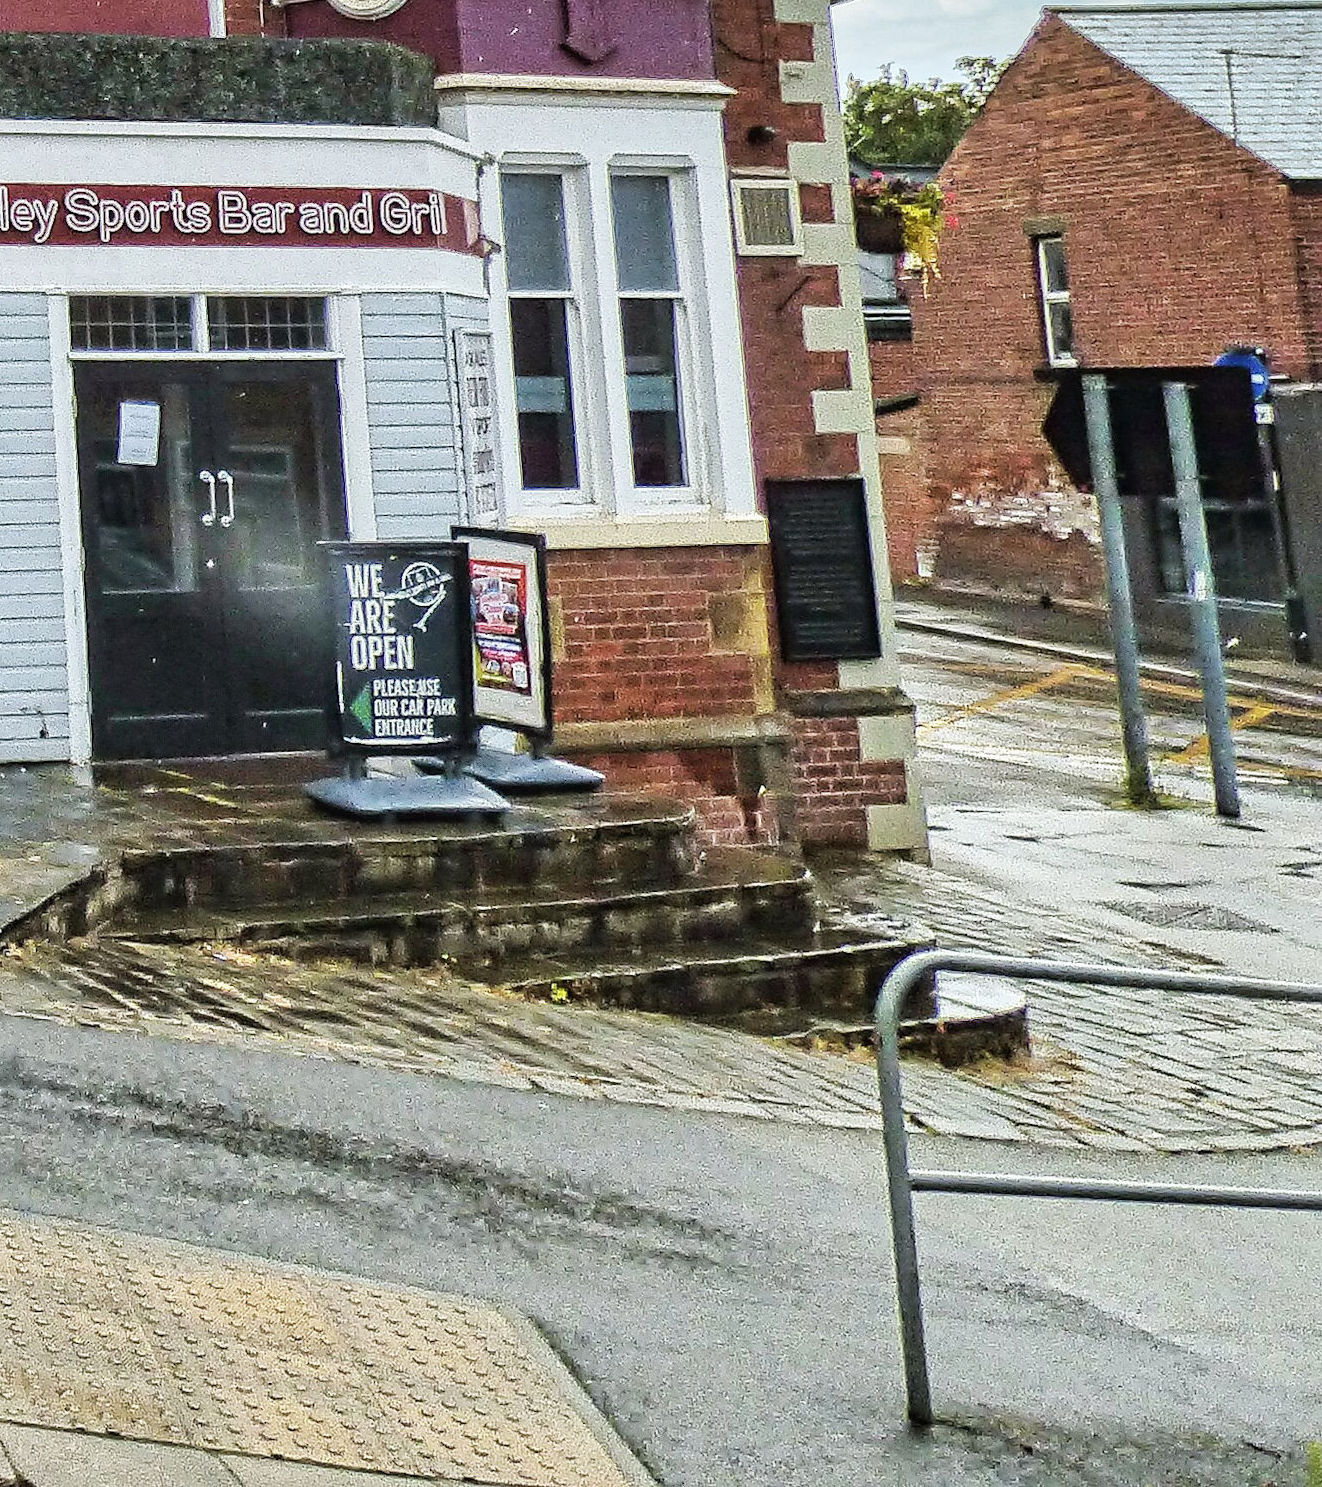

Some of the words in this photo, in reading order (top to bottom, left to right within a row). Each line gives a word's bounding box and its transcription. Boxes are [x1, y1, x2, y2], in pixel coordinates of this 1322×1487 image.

[64, 187, 212, 243] Sports
[217, 190, 295, 235] Bar
[299, 191, 374, 235] and
[346, 563, 384, 598] WE
[349, 599, 397, 635] ARE
[350, 635, 415, 671] OPEN
[373, 678, 417, 697] PLEASE
[418, 678, 442, 697] USE
[374, 698, 399, 717] OUR
[400, 698, 425, 717] CAR
[426, 697, 457, 717] PARK
[374, 718, 435, 737] ENTRANCE
